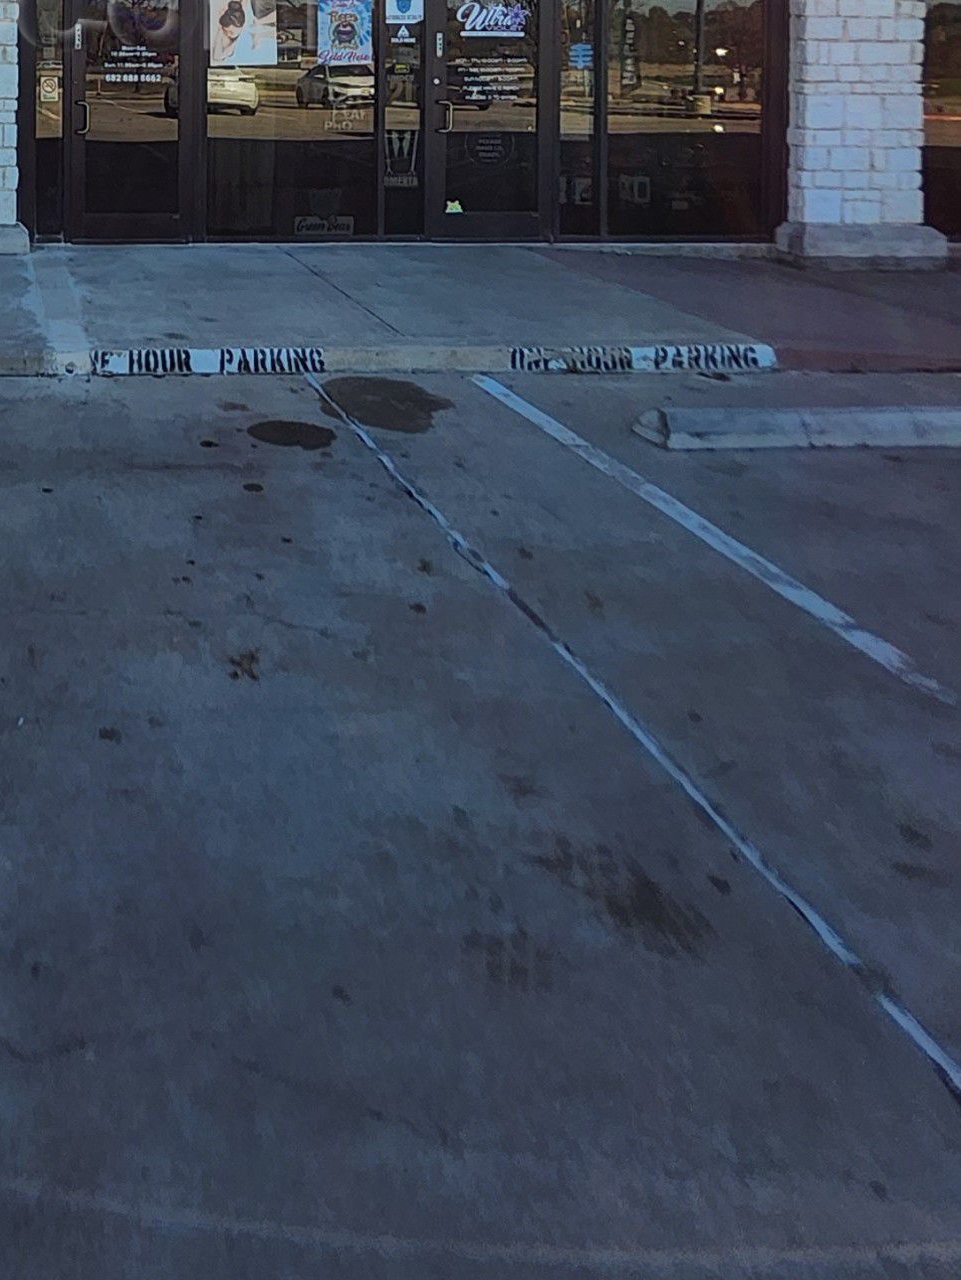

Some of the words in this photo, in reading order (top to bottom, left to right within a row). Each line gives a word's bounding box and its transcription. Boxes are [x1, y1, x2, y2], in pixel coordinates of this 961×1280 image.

[128, 349, 193, 373] HOUR
[220, 348, 326, 374] PARKING
[655, 345, 760, 370] PARKING
